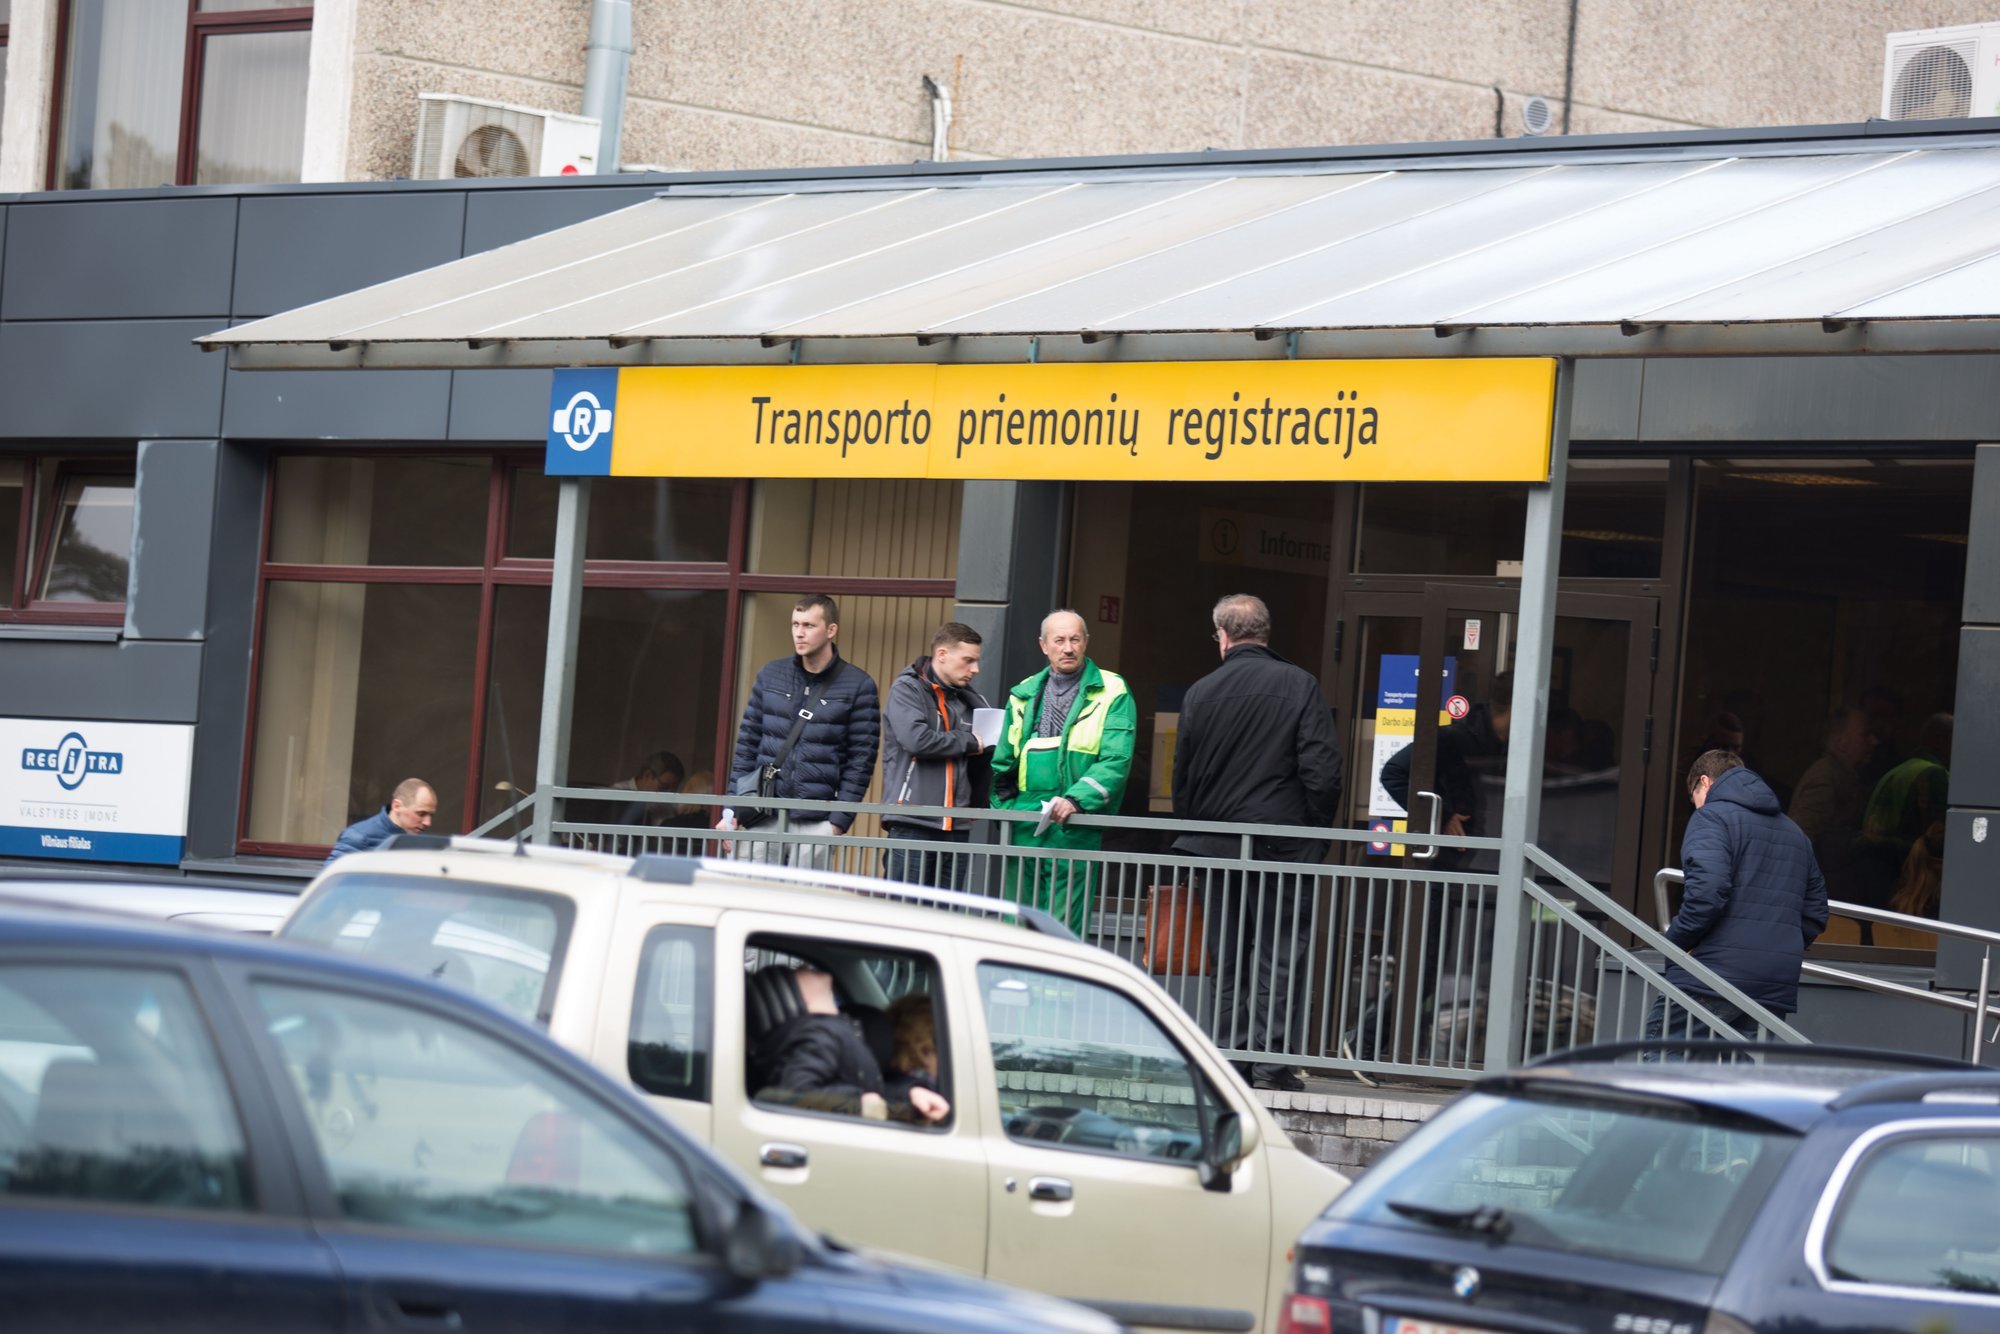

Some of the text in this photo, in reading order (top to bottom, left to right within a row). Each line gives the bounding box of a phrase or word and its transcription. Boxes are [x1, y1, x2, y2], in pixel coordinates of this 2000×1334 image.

[752, 390, 1378, 460] Transporto priemonių registracija
[1382, 717, 1401, 727] Darbo
[41, 834, 68, 849] Vilnius
